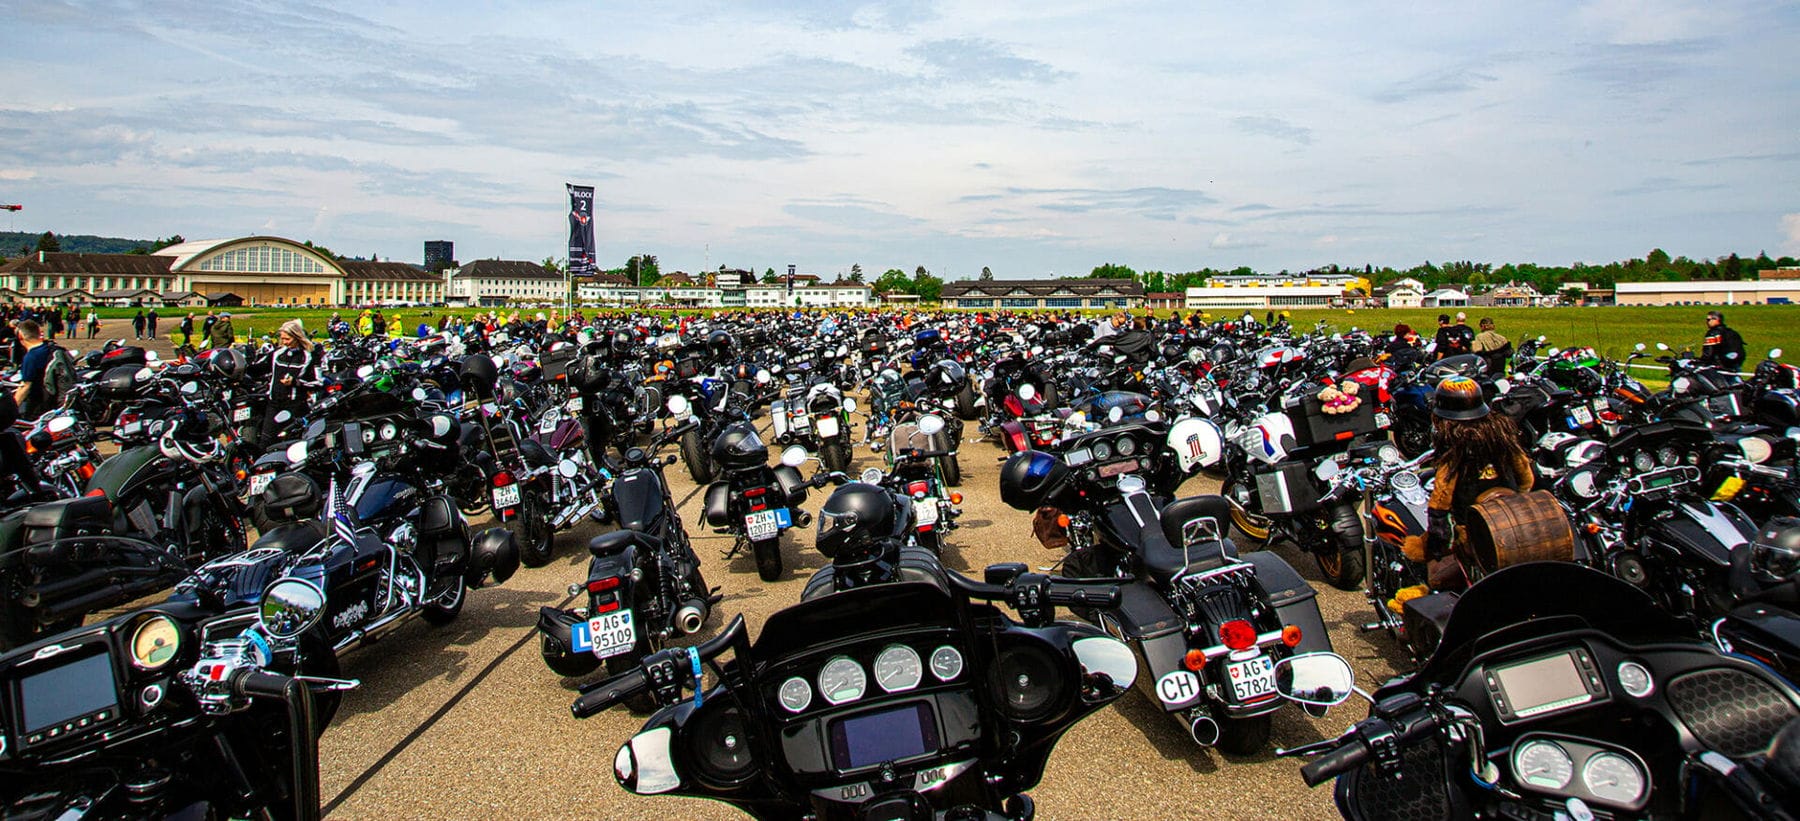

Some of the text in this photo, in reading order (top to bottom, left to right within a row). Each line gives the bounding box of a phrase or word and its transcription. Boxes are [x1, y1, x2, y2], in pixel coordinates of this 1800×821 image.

[580, 200, 587, 211] 2
[755, 513, 767, 524] ZH
[776, 511, 788, 526] L
[603, 615, 619, 631] AG
[578, 626, 592, 648] L
[593, 628, 632, 649] 95109
[1243, 660, 1261, 679] AG
[1162, 673, 1194, 701] CH
